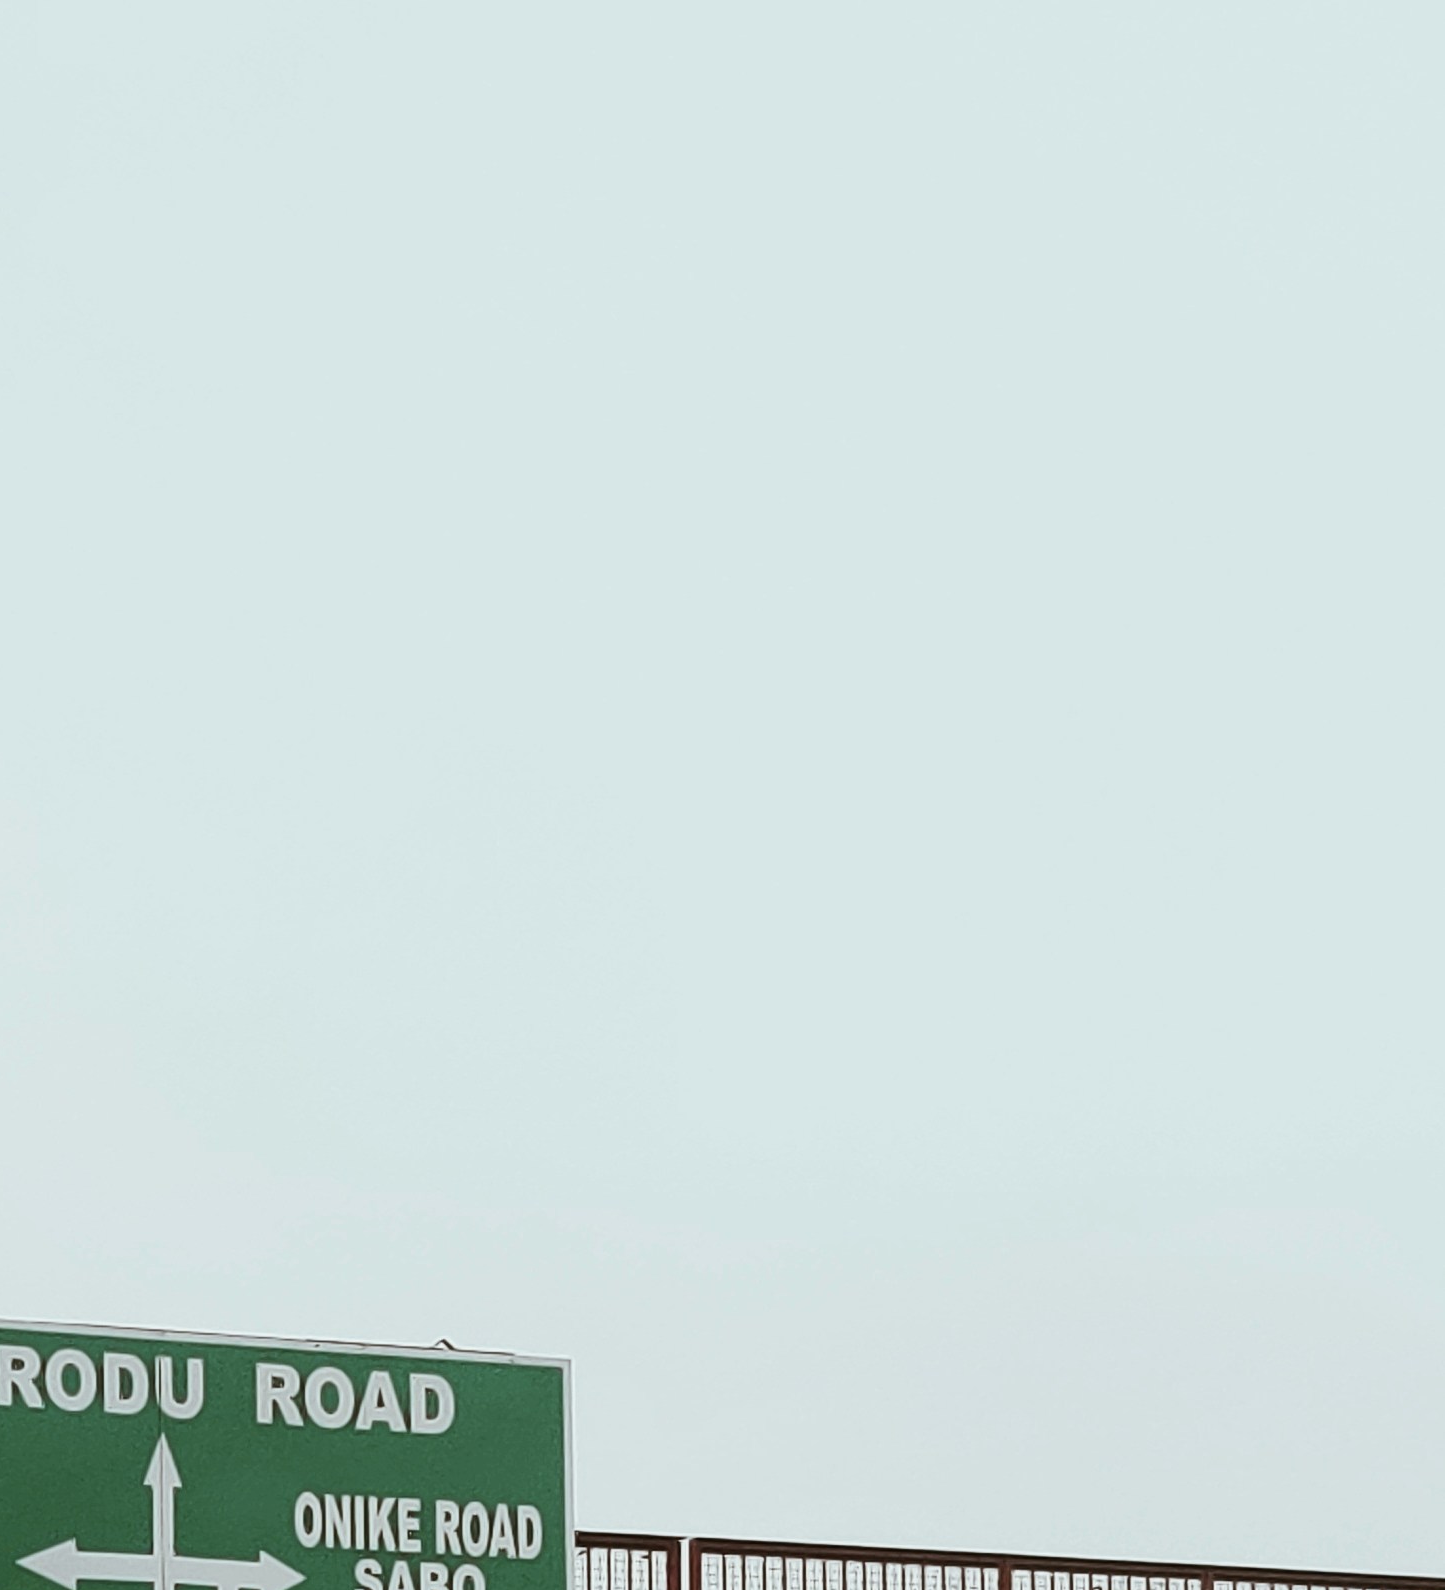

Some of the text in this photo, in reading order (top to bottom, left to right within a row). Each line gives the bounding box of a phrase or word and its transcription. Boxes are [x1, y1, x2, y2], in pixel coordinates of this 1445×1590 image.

[255, 1361, 456, 1435] ROAD
[293, 1490, 544, 1561] ONIKE ROAD
